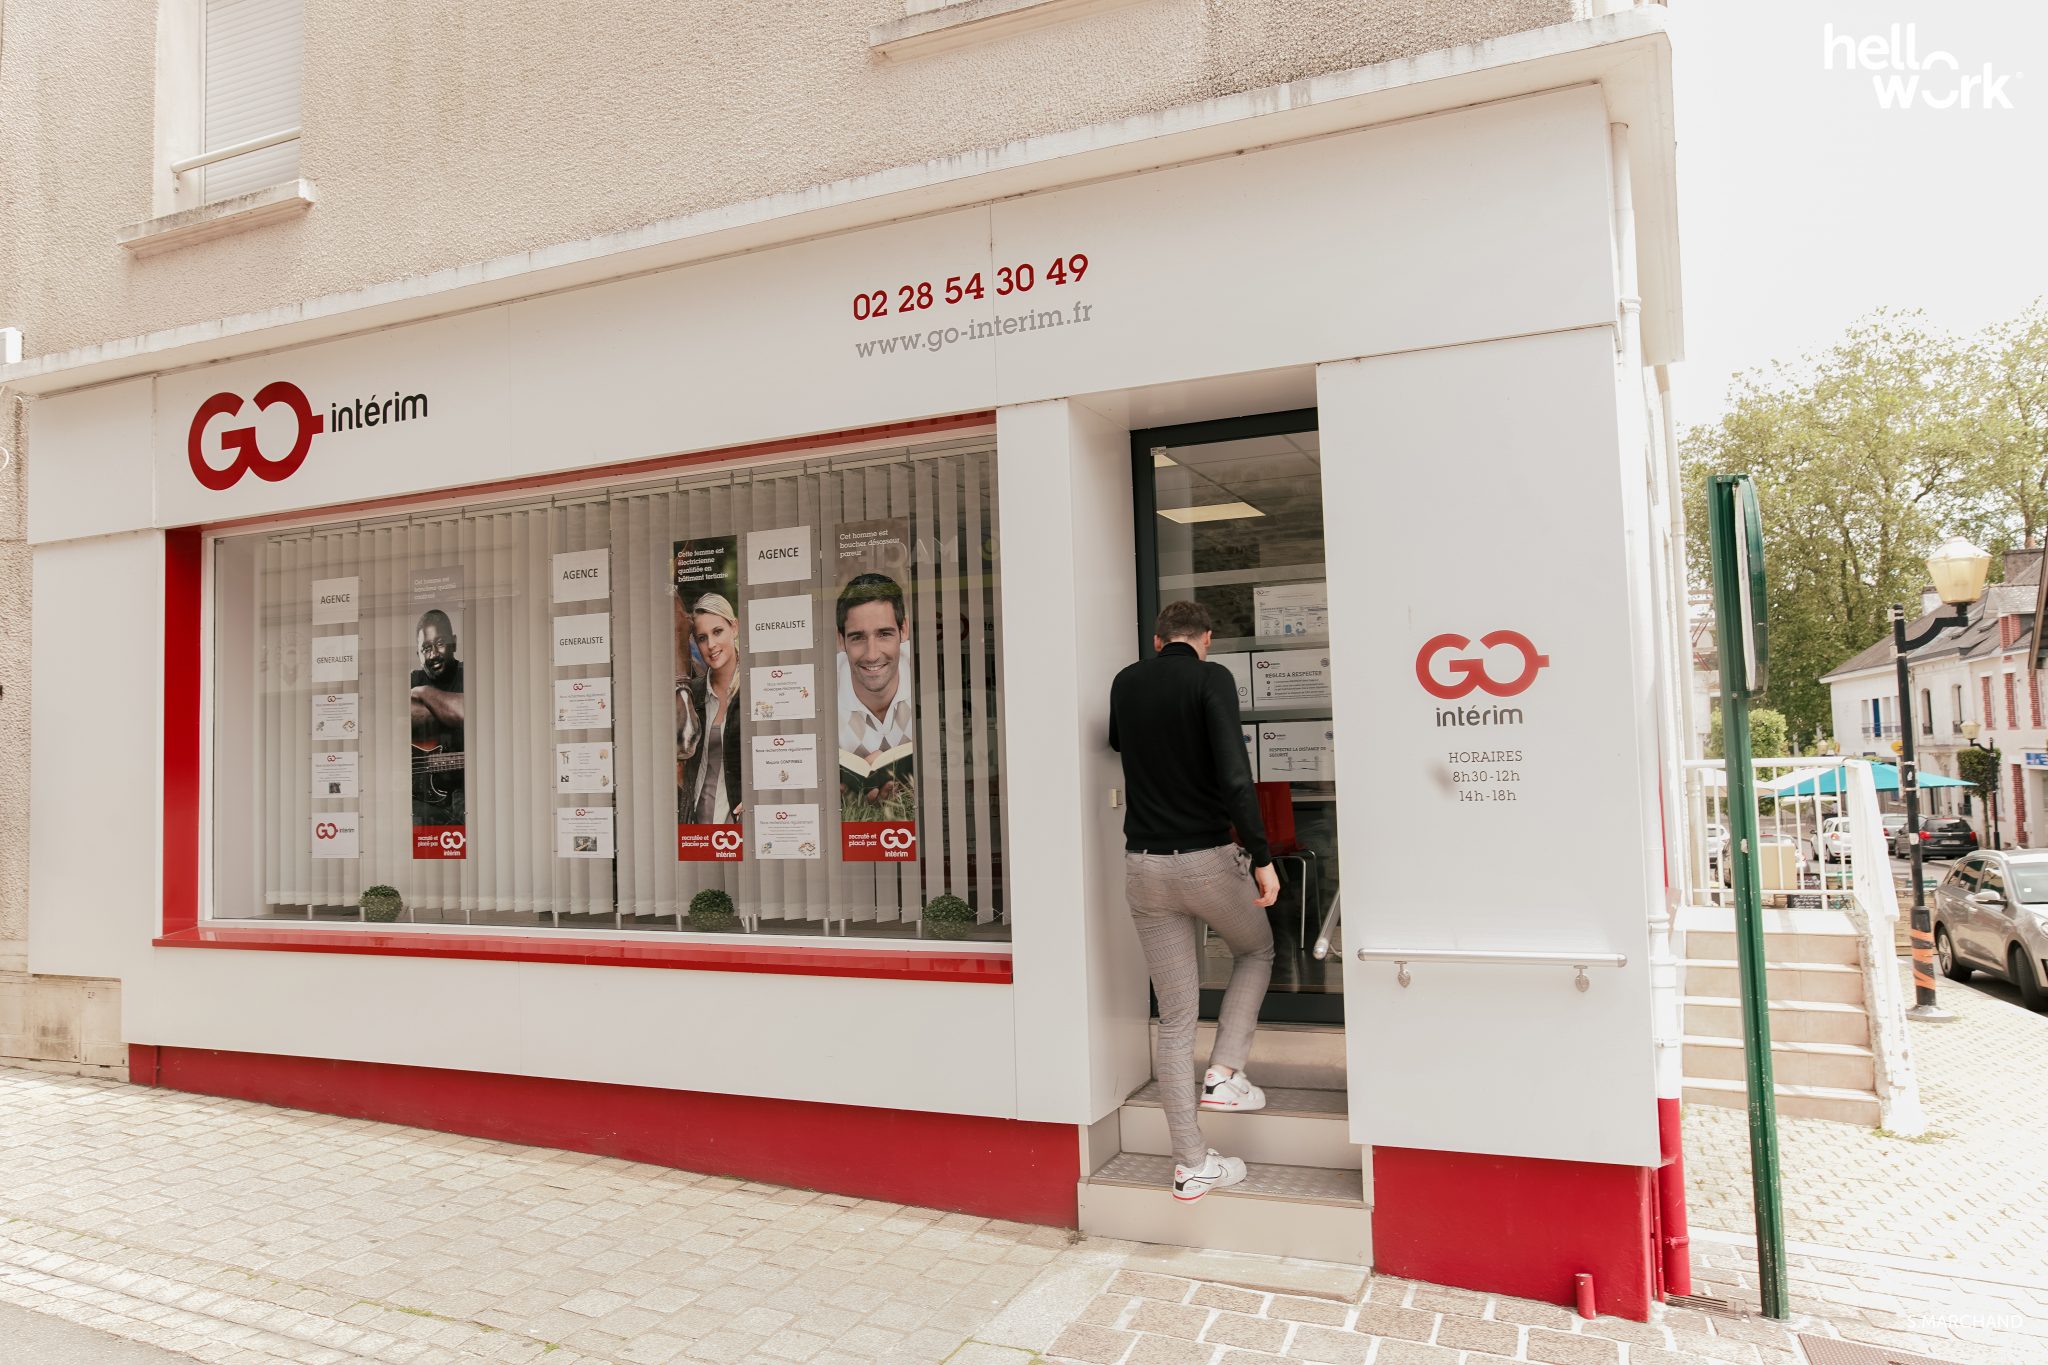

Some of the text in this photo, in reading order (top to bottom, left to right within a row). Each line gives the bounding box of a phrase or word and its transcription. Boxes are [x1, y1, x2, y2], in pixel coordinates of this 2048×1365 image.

[853, 253, 1089, 321] 02 28 54 30 49
[855, 300, 1093, 358] www.go-interim.fr
[188, 381, 428, 491] GO intérim
[852, 531, 877, 539] homme
[758, 547, 799, 560] AGENCE
[563, 568, 598, 580] AGENCE
[320, 593, 350, 605] AGENCE
[755, 620, 805, 631] GENERALISTE
[560, 636, 603, 646] GENERALISTE
[316, 655, 353, 665] GENERALISTE
[1415, 630, 1550, 700] GO
[1436, 704, 1523, 727] intérim
[1448, 751, 1523, 763] HORAIRES
[440, 831, 466, 849] GO
[712, 830, 743, 850] GO
[880, 828, 916, 849] GO
